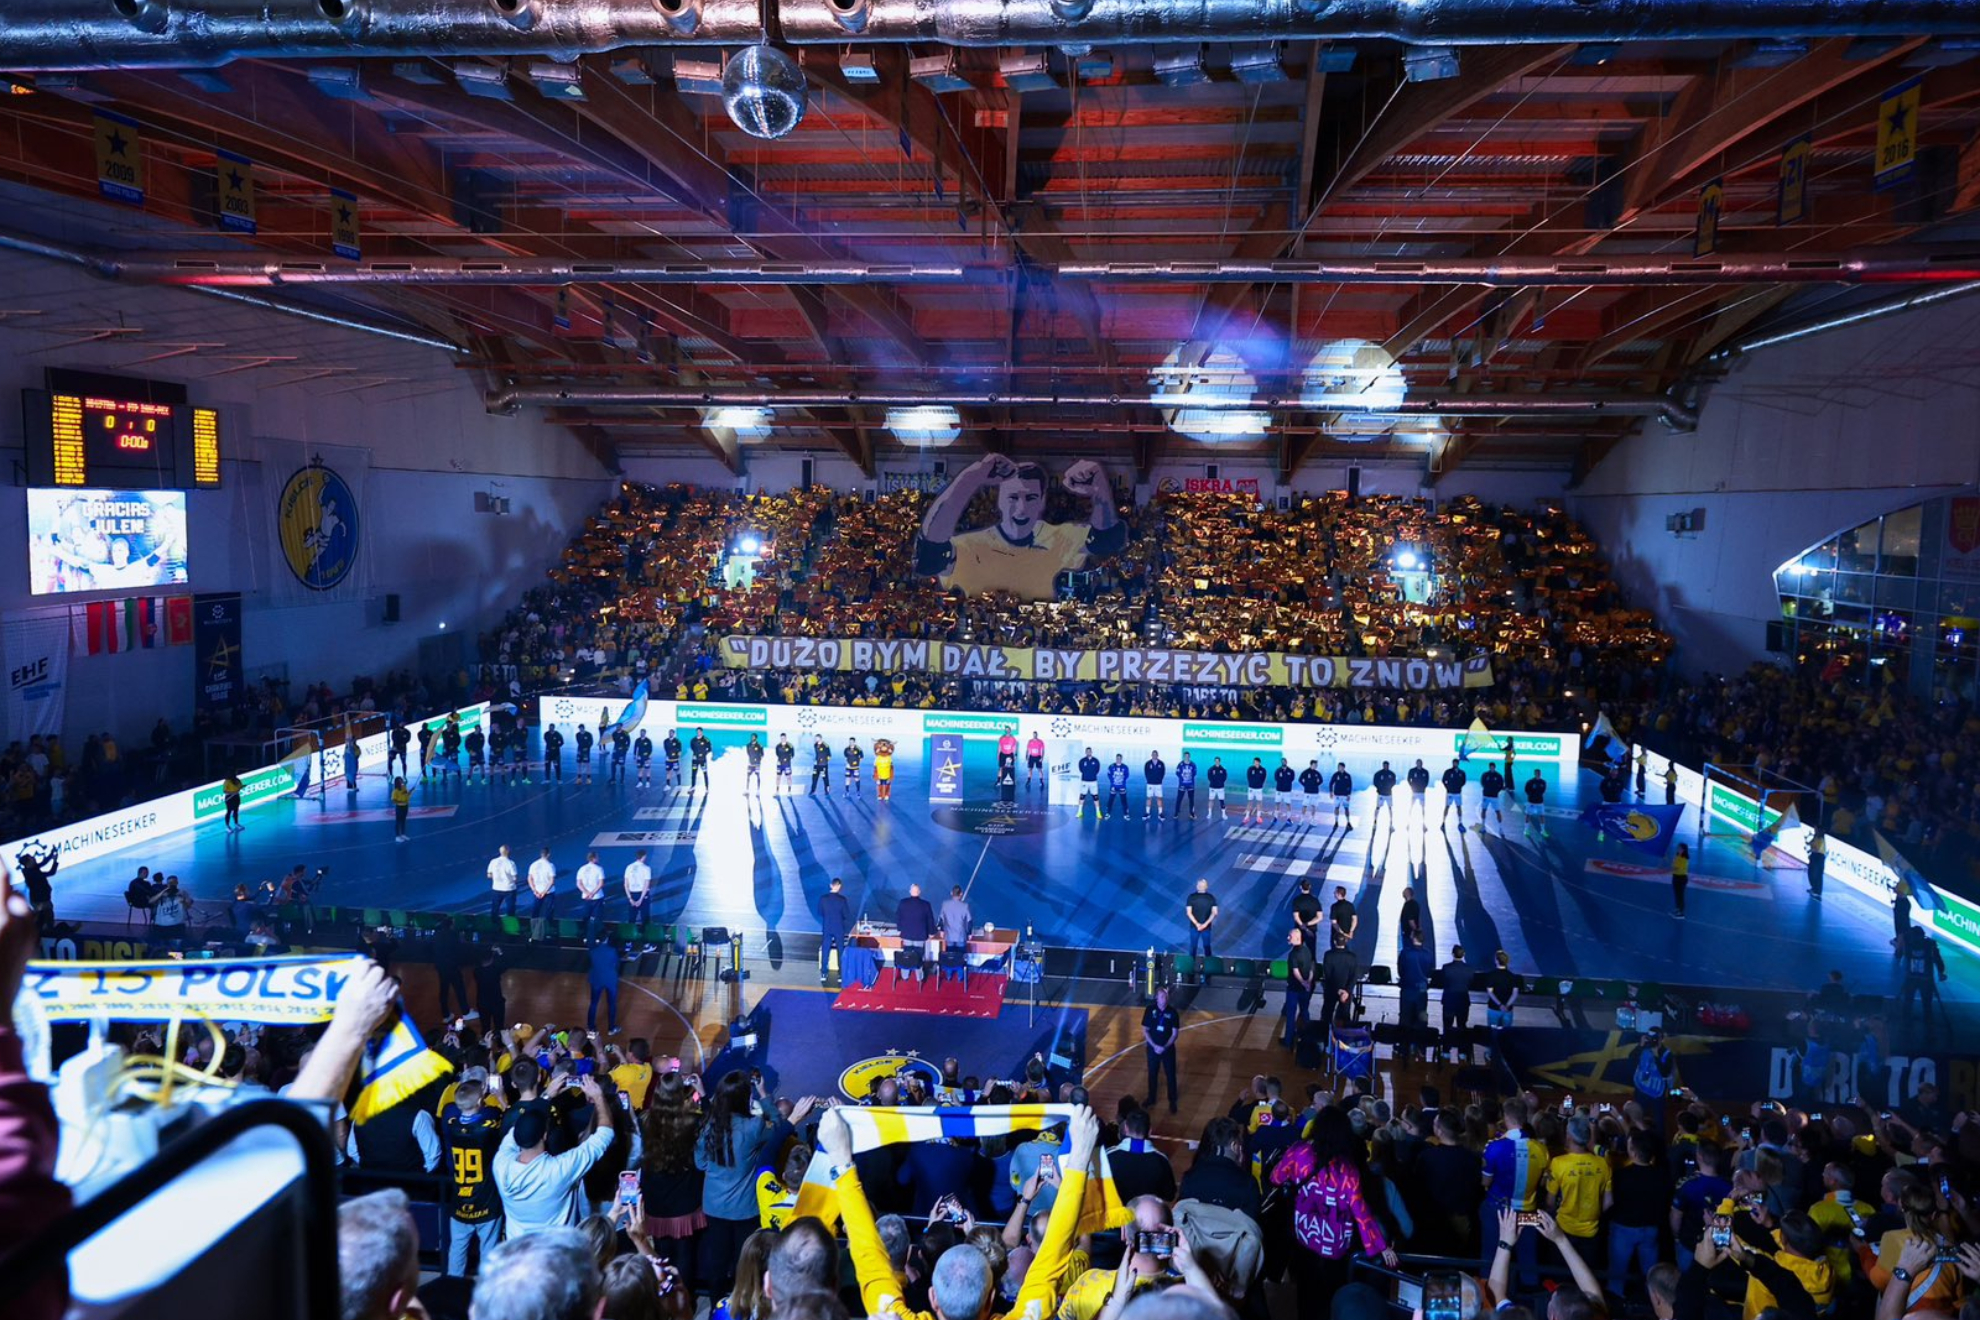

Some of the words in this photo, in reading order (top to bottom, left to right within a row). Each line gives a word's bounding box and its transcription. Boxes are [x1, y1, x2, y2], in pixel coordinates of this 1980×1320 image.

[1882, 139, 1909, 166] 2016
[105, 160, 135, 183] 2009
[225, 194, 249, 214] 2003
[105, 415, 115, 429] 0
[146, 419, 156, 432] 0
[1184, 478, 1234, 492] ISKRA
[83, 502, 151, 517] GRACIAS
[11, 656, 48, 686] EHF
[854, 641, 927, 670] BYM
[943, 645, 1018, 679] DAŁ,
[1036, 650, 1082, 679] BY
[1285, 656, 1332, 686] TO
[678, 709, 766, 722] MACHINESEEKER.COM
[819, 713, 893, 725] MACHINESEEKER
[926, 718, 1017, 731] MACHINESEEKER.COM
[1073, 723, 1151, 735] MACHINESEEKER
[1185, 729, 1281, 741] MACHINESEEKER.COM
[1339, 733, 1422, 745] MACHINESEEKER
[1051, 762, 1071, 773] EHF
[197, 773, 293, 810] MACHSEEKER.COM
[53, 812, 158, 856] MACHINESEEKER
[1768, 1047, 1860, 1104] DR
[1884, 1055, 1937, 1107] TO
[451, 1146, 484, 1185] 99
